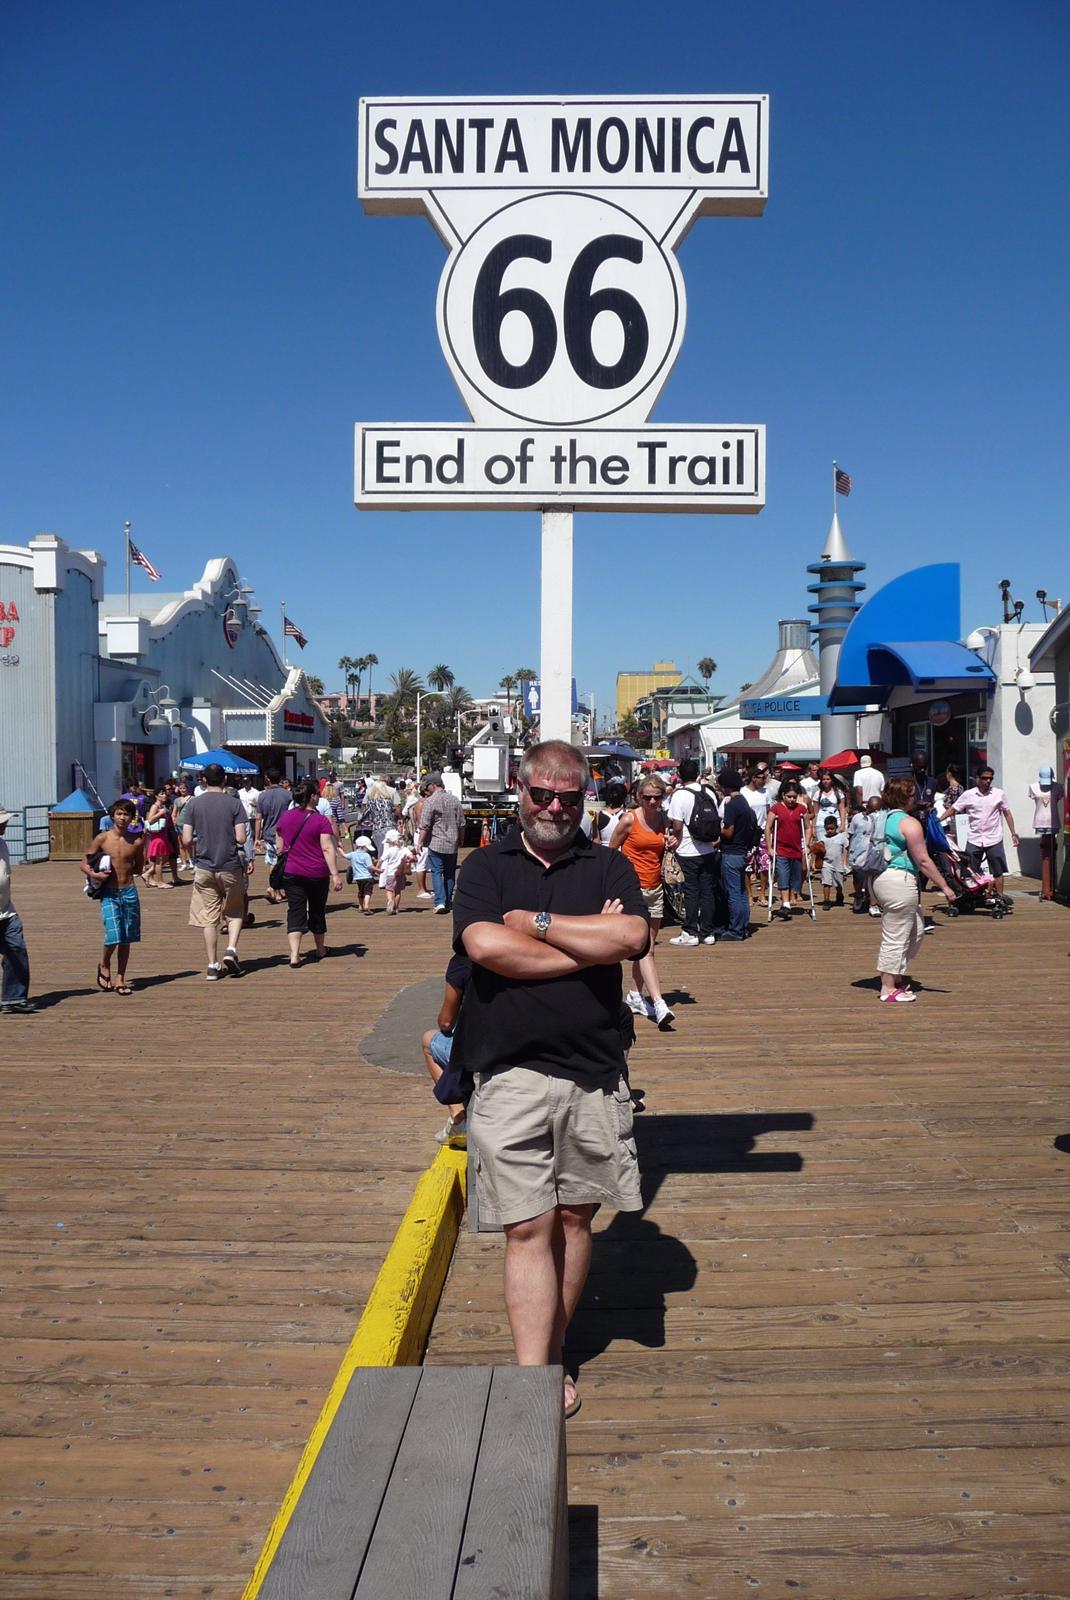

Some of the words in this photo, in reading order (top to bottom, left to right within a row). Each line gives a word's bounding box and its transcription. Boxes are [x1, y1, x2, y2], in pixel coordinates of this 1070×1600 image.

[374, 117, 529, 176] SANTA
[551, 116, 751, 175] MONICA
[472, 233, 649, 390] 66
[375, 437, 465, 485] End
[484, 437, 534, 485] of
[550, 438, 630, 485] the
[637, 438, 744, 486] Trail
[764, 700, 800, 712] POLICE
